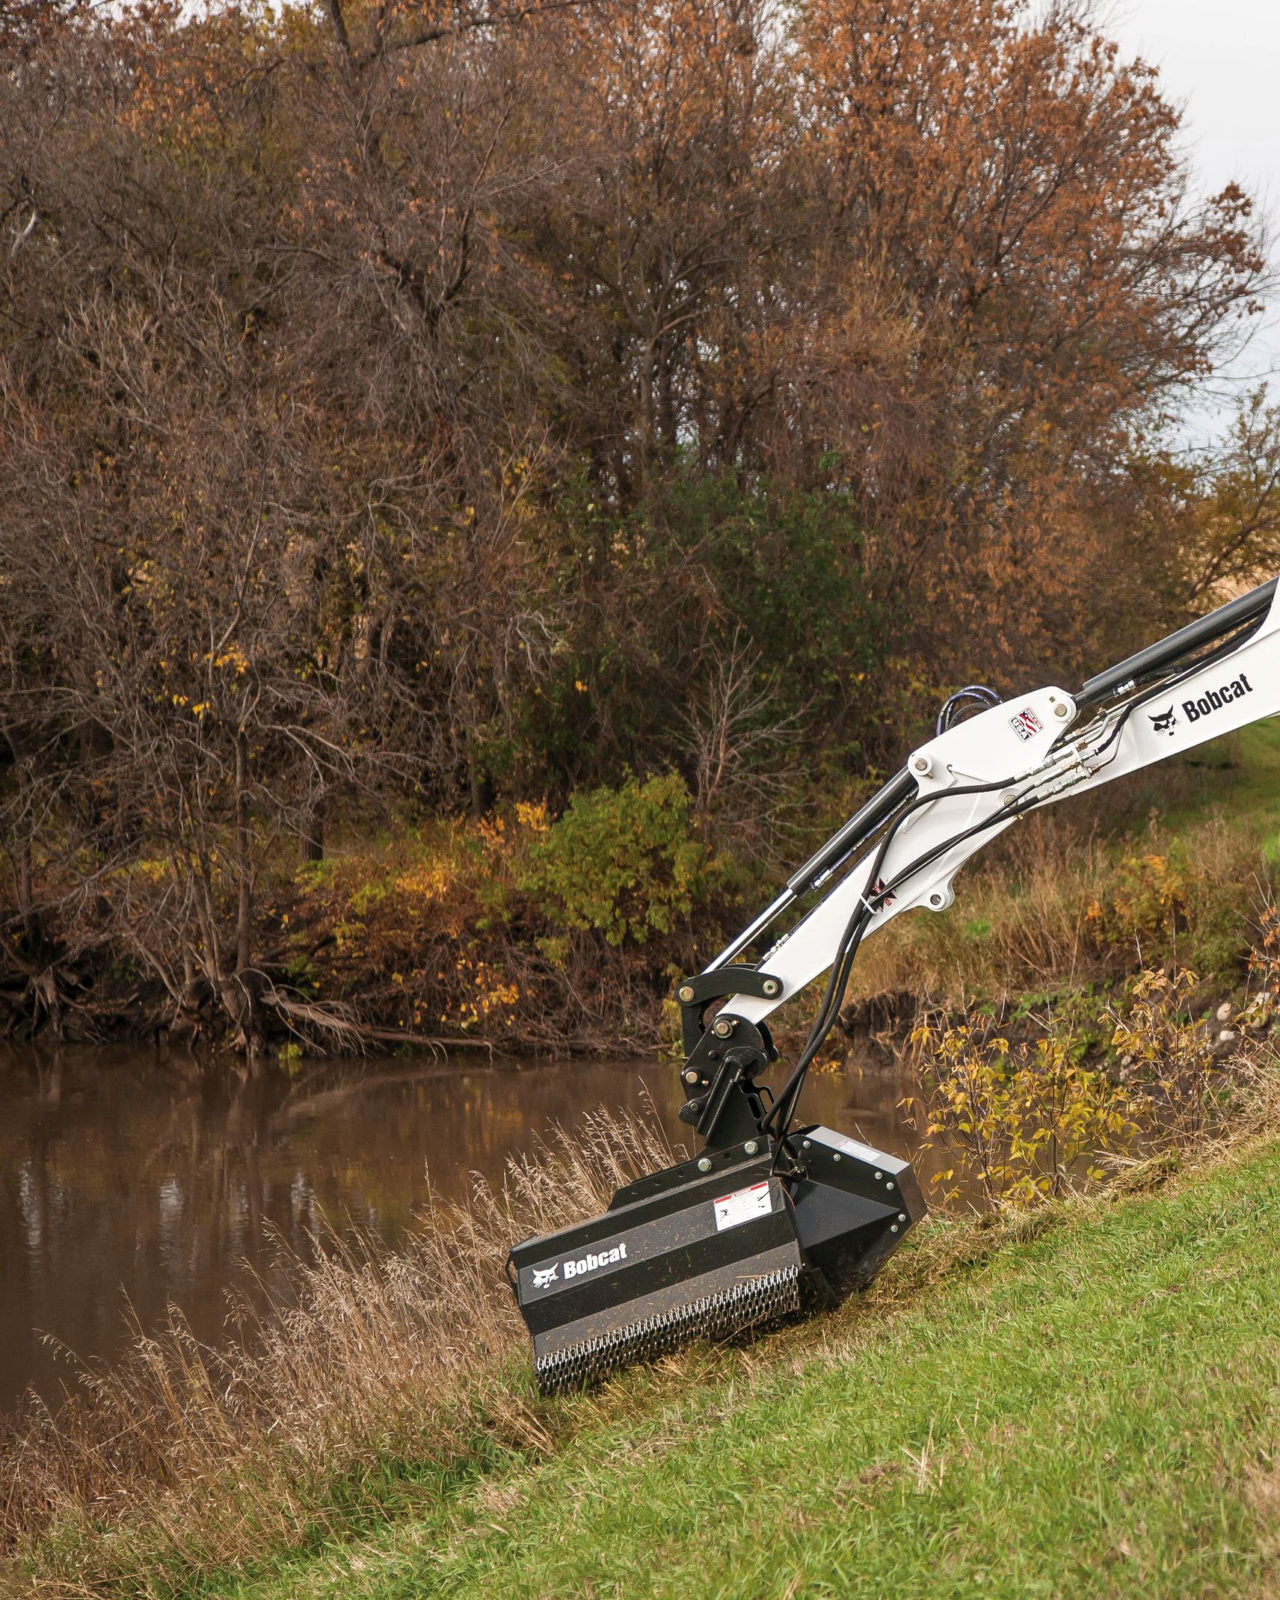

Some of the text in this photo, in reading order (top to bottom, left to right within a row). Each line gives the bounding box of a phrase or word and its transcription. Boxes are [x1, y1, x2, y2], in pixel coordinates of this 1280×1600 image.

[1182, 673, 1253, 723] Bobcat
[1011, 717, 1029, 740] USA
[563, 1243, 627, 1279] Bobcat
